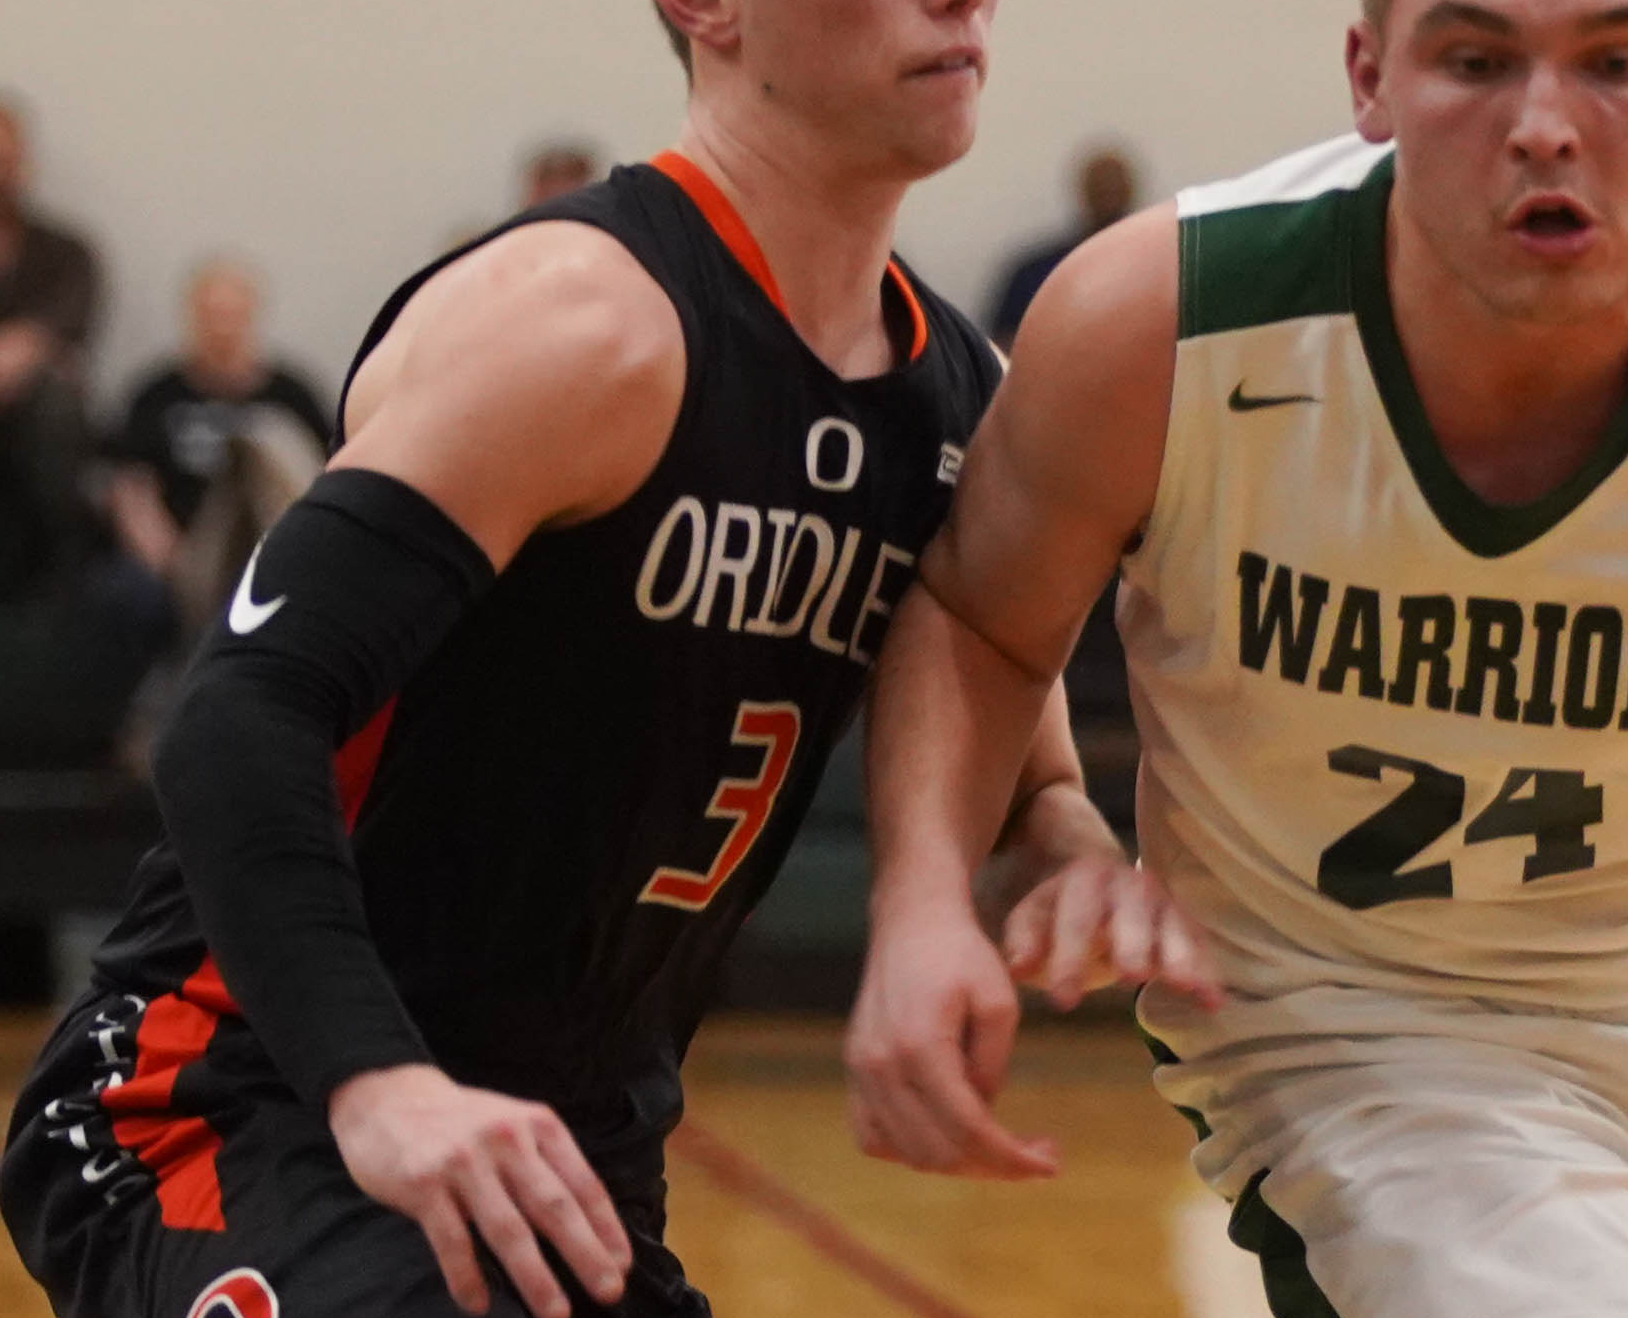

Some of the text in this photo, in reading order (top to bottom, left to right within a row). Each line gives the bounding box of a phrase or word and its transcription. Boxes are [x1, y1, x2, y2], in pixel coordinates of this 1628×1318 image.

[806, 416, 864, 492] O
[635, 495, 915, 667] ORIOLE
[637, 700, 800, 912] 3
[1317, 743, 1604, 911] 24
